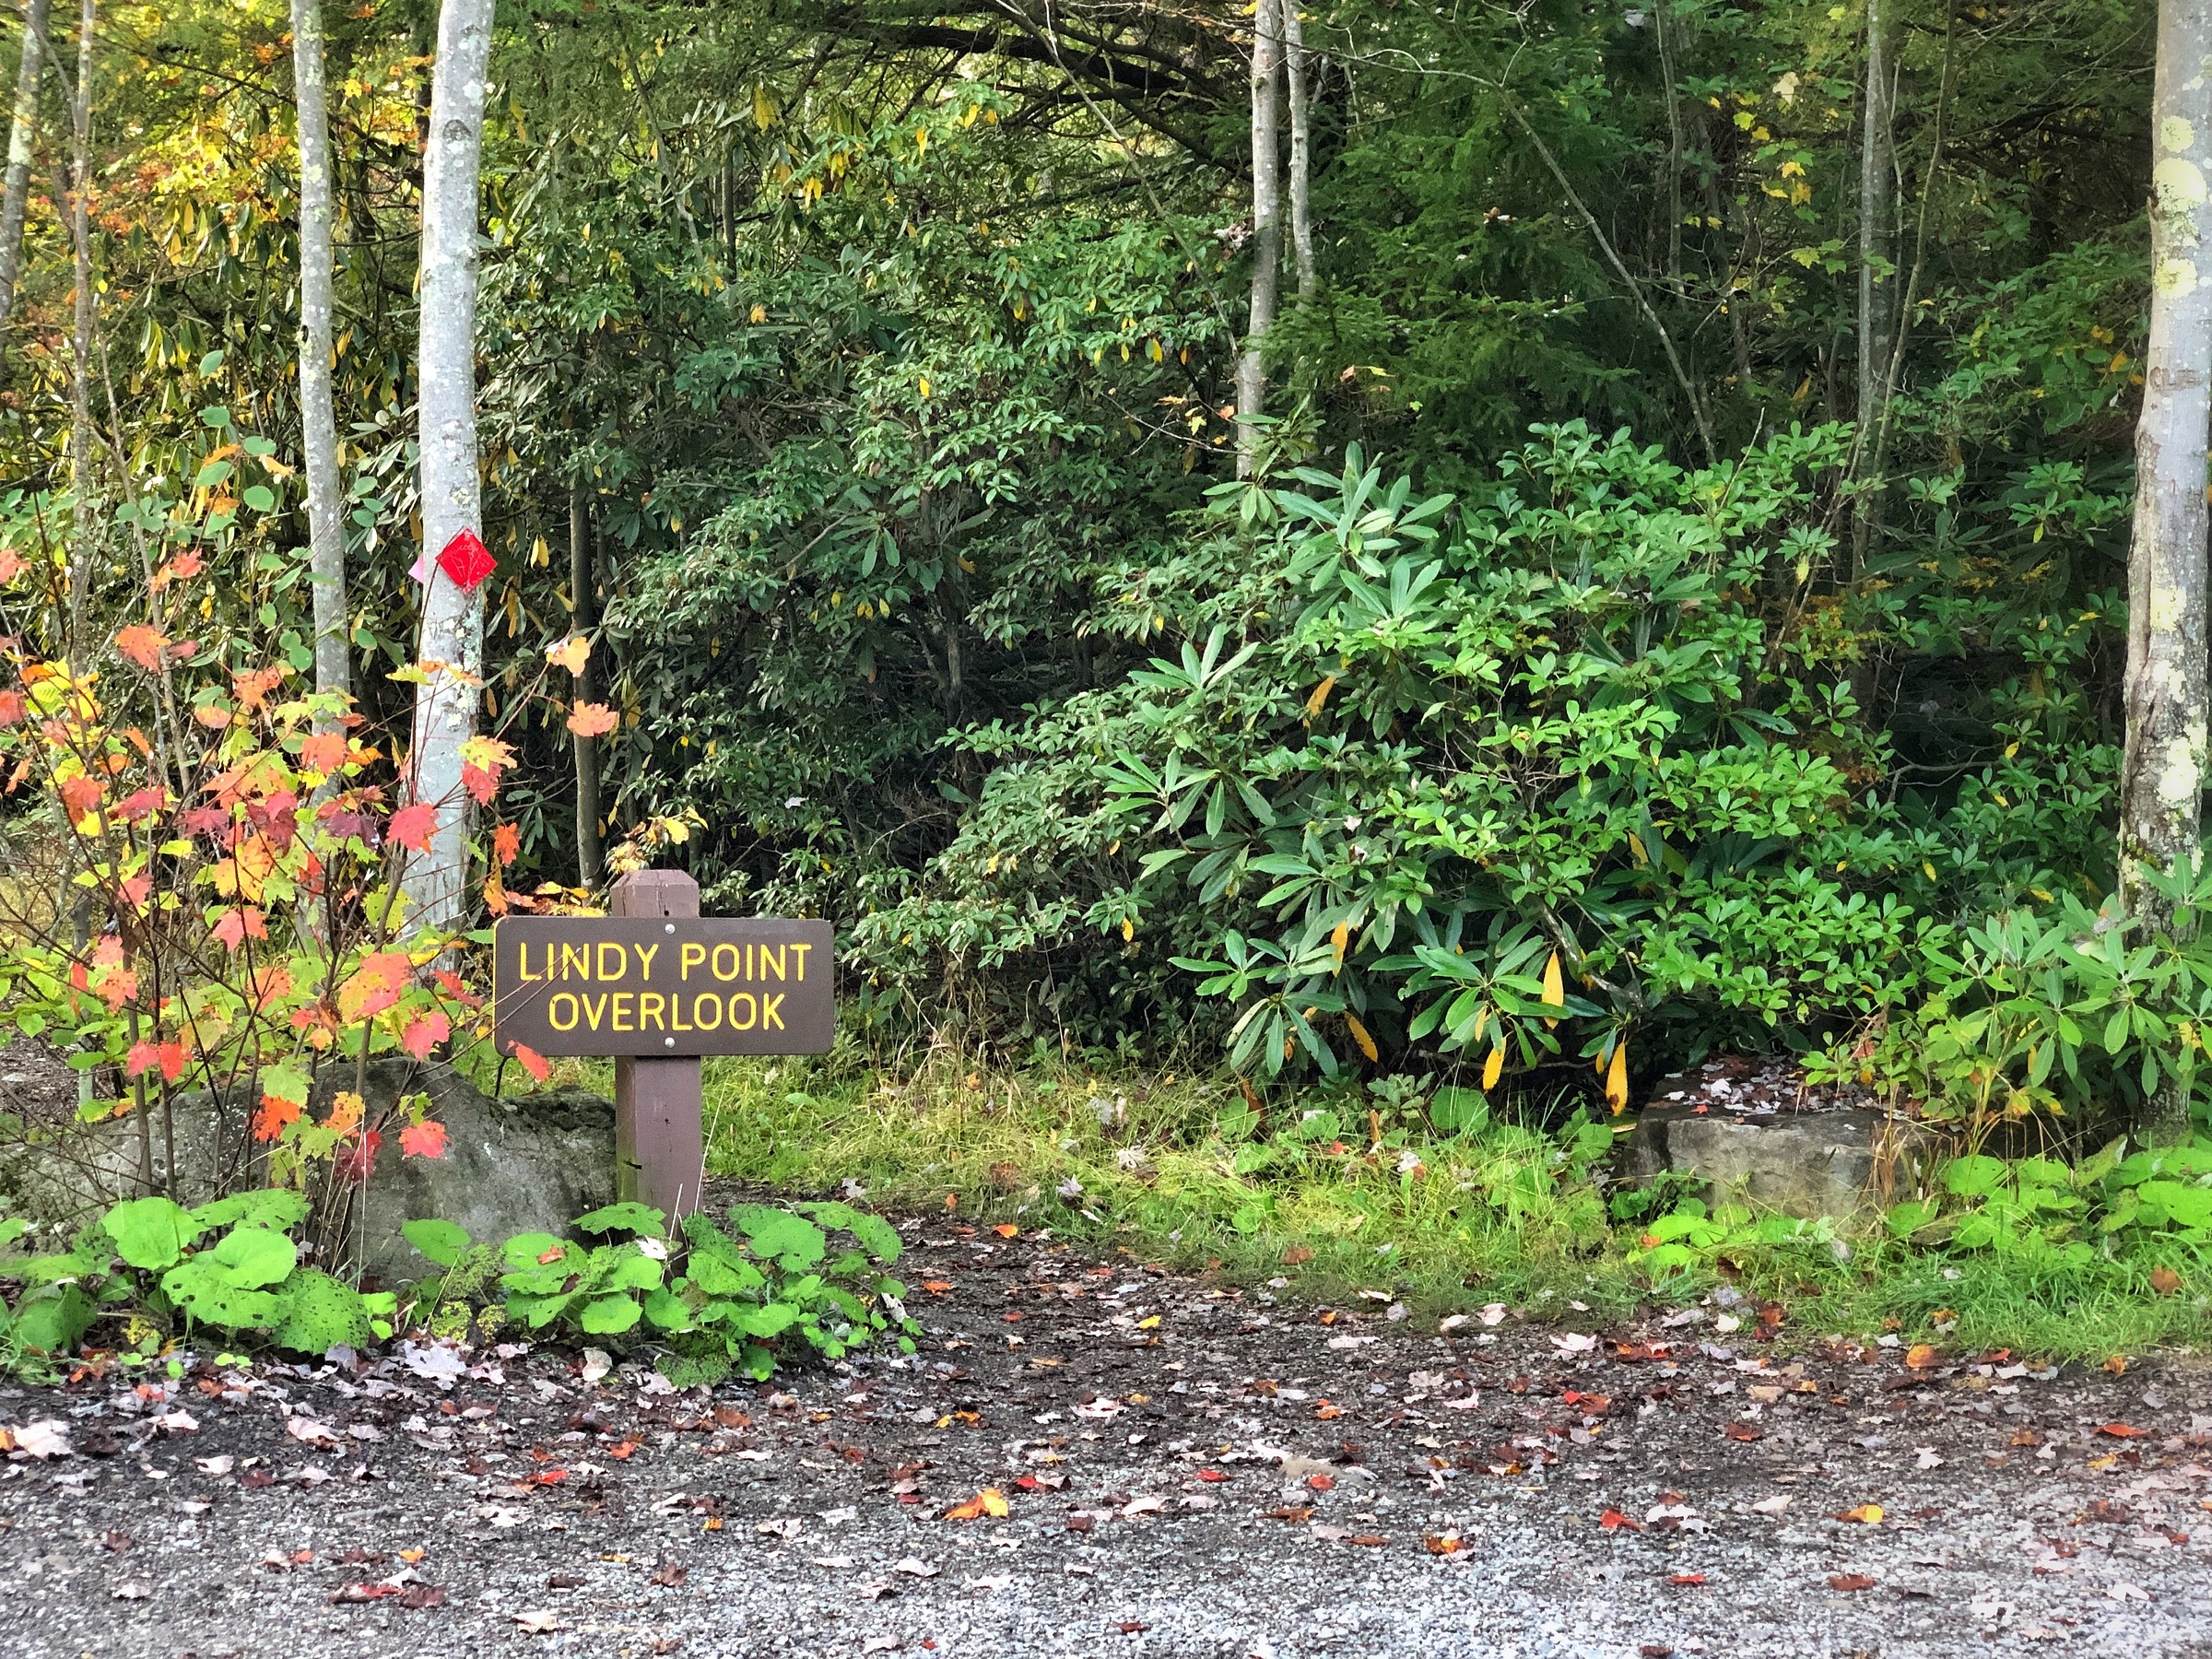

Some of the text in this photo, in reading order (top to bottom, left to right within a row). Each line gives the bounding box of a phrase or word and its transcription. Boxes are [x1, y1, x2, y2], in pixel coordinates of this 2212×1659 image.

[518, 941, 813, 982] LINDY POINT
[548, 991, 786, 1031] OVERLOOK
